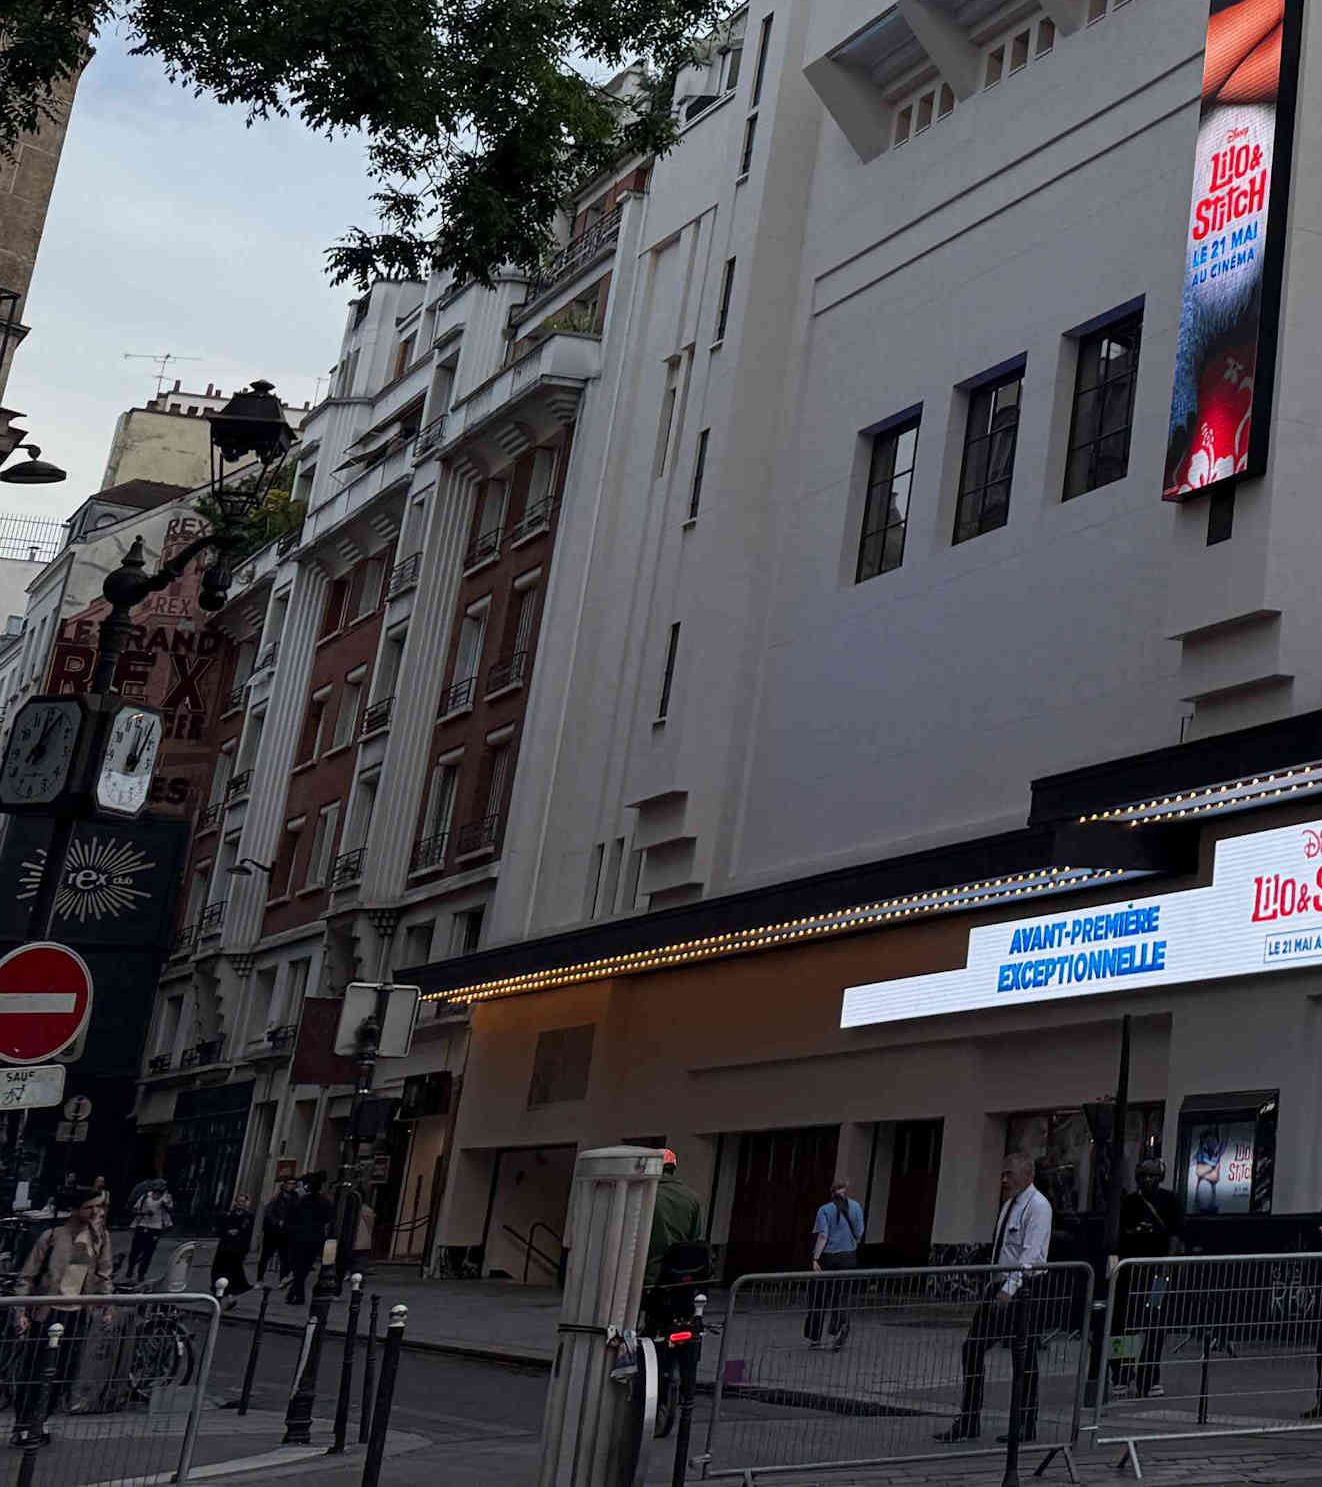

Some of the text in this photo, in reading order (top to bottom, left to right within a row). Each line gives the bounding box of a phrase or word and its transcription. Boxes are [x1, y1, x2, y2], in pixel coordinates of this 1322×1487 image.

[1250, 143, 1263, 172] &
[1192, 220, 1258, 268] LE 21 MAI
[1192, 268, 1207, 287] AU
[127, 622, 223, 654] RAND
[47, 649, 219, 712] REX
[1297, 882, 1312, 914] &
[1009, 903, 1161, 955] AVANT-PREMIÈRE
[1268, 940, 1281, 956] LE
[1282, 939, 1293, 954] 21
[1294, 937, 1313, 953] MAI
[997, 940, 1168, 993] EXCEPTIONNELLE
